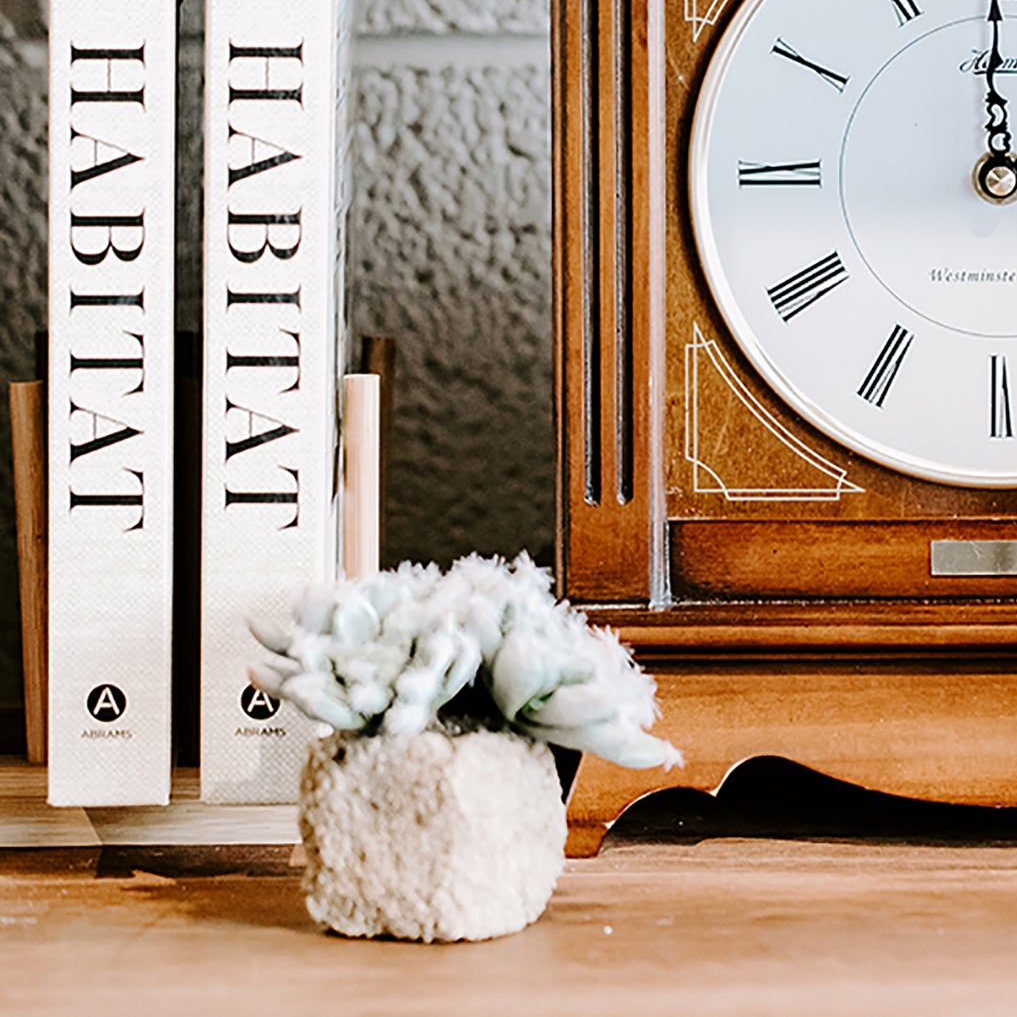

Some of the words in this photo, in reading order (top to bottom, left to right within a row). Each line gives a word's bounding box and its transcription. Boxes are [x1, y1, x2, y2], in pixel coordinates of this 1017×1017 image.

[69, 38, 147, 533] HABITAT
[224, 38, 304, 531] HABITAT
[81, 729, 132, 739] ABRAMS
[235, 726, 287, 736] ABRAMS
